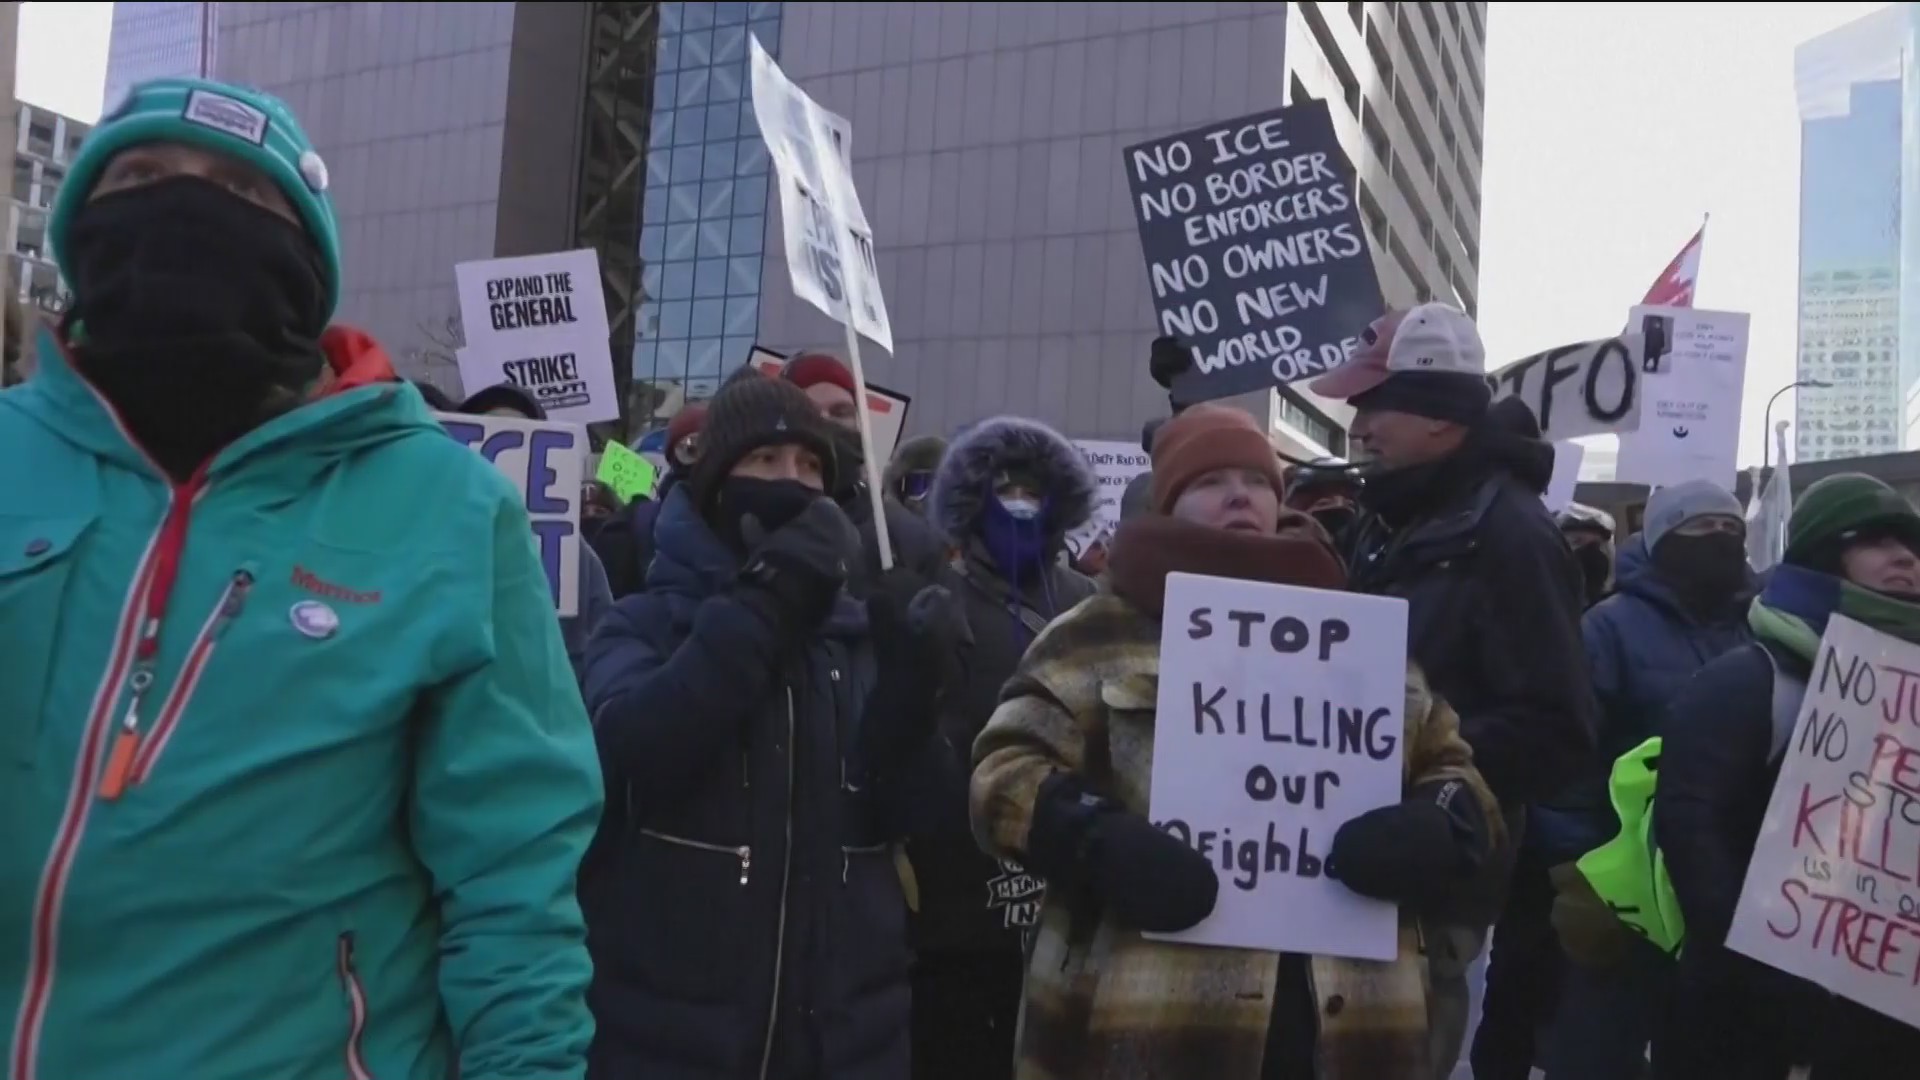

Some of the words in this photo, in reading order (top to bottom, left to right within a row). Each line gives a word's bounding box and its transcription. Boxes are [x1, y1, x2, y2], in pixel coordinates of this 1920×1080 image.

[1133, 141, 1192, 182] NO
[1205, 119, 1290, 164] ICE
[1140, 182, 1197, 221] NO
[1205, 152, 1336, 206] BORDER
[1184, 183, 1349, 246] ENFORCERS
[486, 275, 544, 300] EXPAND
[545, 271, 573, 294] THE
[1152, 254, 1210, 298] NO
[1223, 223, 1361, 279] OWNERS
[490, 296, 578, 330] GENERAL
[1162, 299, 1219, 337] NO
[1235, 274, 1328, 325] NEW
[503, 353, 578, 387] STRIKE!
[1192, 325, 1302, 375] WORLD
[1485, 339, 1636, 432] TFO
[1187, 607, 1350, 661] STOP
[1819, 645, 1876, 706] NO
[1193, 681, 1397, 760] KILLING
[1799, 708, 1848, 762] NO
